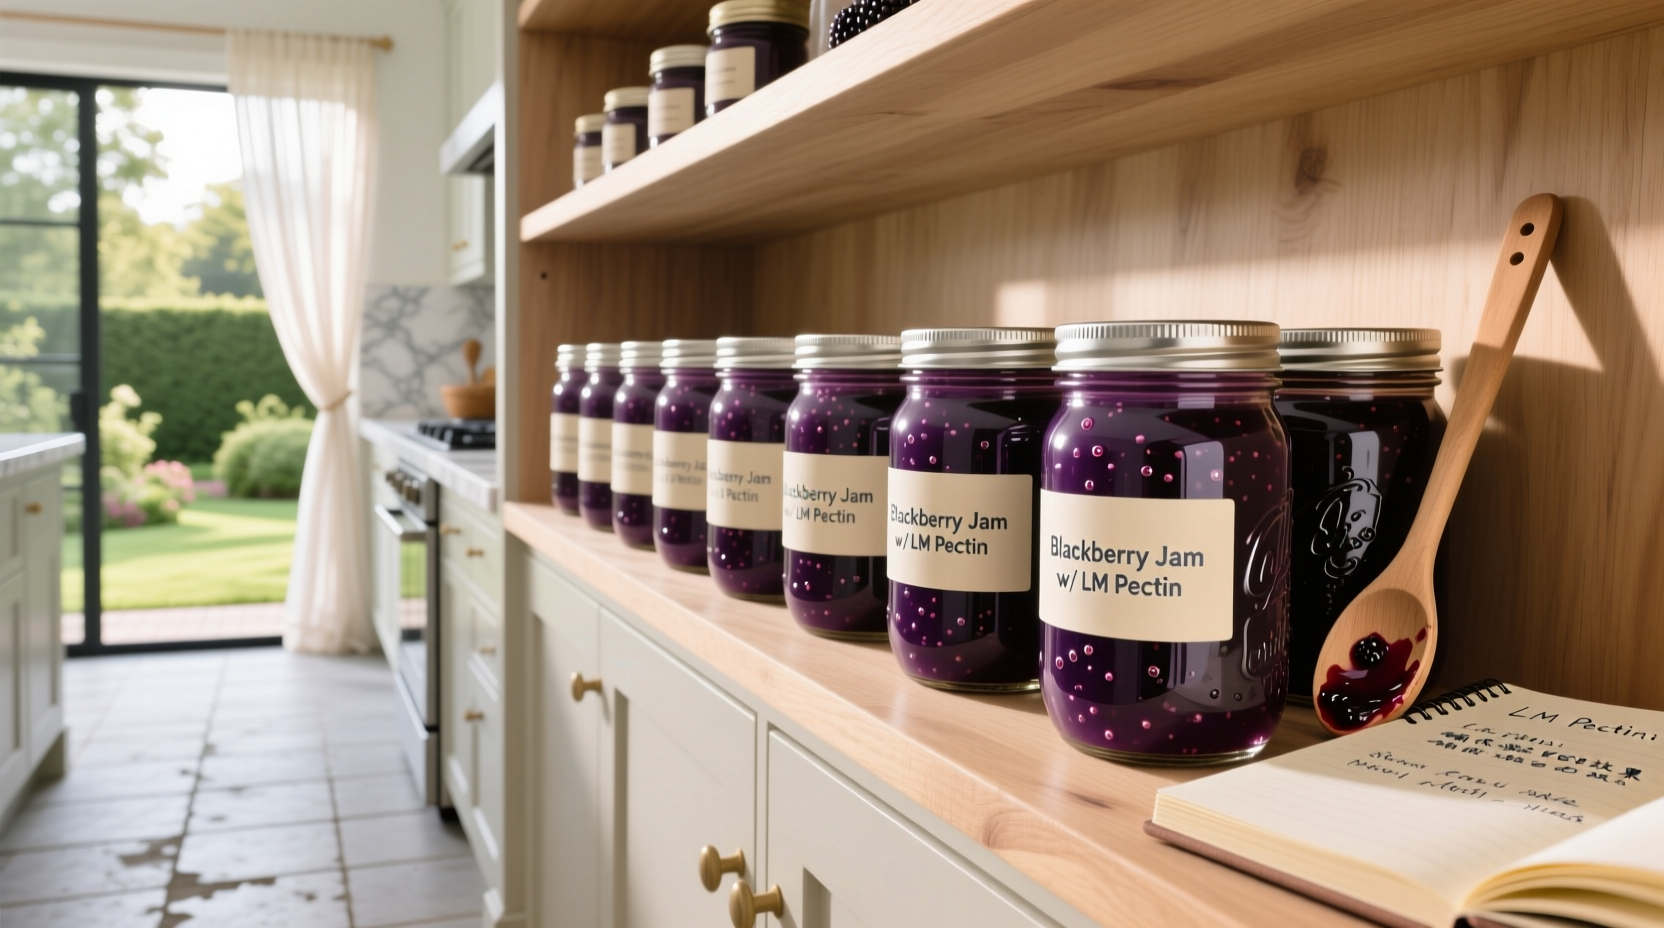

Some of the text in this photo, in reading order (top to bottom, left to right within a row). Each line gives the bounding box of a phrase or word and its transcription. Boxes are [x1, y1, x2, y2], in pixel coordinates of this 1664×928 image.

[747, 471, 771, 485] Jam
[784, 483, 873, 507] ckberry Jam
[796, 506, 809, 520] LM
[813, 507, 855, 523] Pectin
[968, 512, 1008, 530] Jam
[895, 533, 988, 555] w/ LM Pectin
[1051, 535, 1204, 572] Blackberry Jam
[1057, 569, 1182, 597] w/ LM Pectin
[1508, 706, 1559, 723] LM
